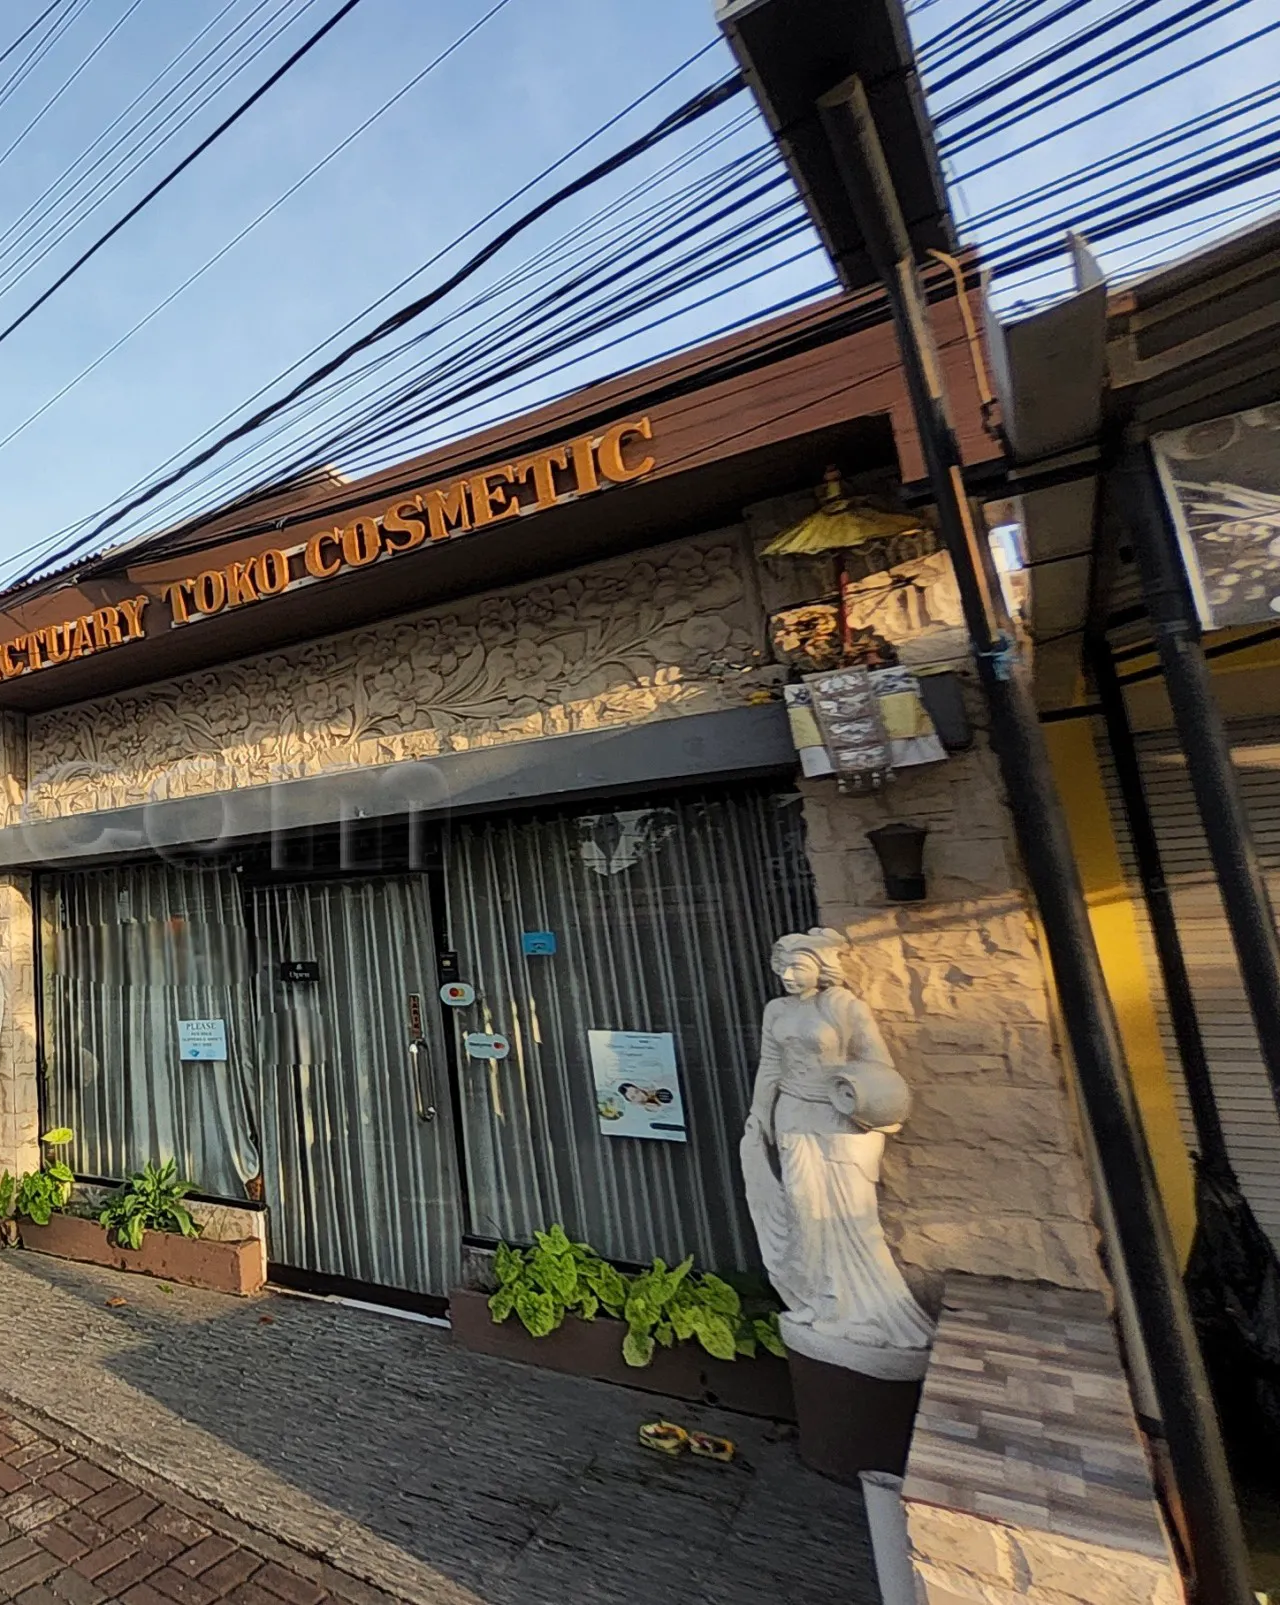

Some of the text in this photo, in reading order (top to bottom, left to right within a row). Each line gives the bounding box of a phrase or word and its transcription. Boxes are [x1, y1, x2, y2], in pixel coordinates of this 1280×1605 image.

[161, 548, 289, 625] TOKO
[304, 416, 656, 579] COSMETIC
[186, 1022, 217, 1031] PLEASE
